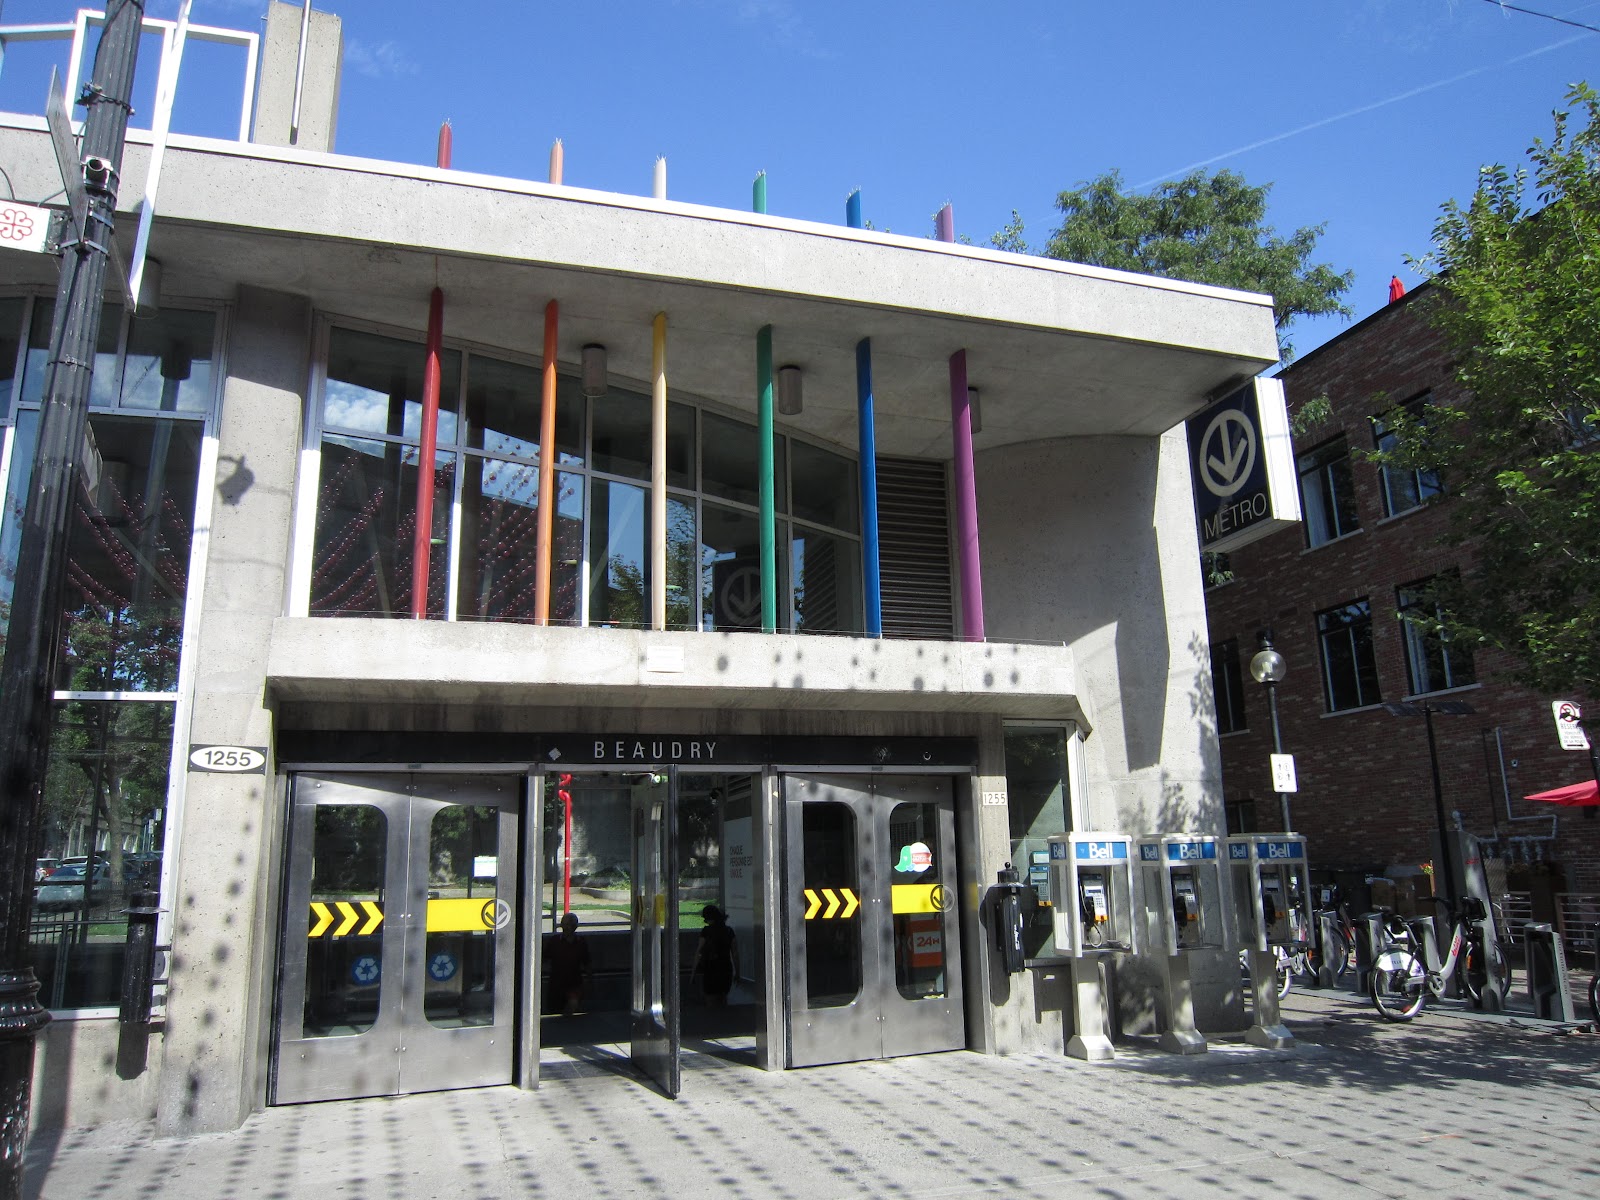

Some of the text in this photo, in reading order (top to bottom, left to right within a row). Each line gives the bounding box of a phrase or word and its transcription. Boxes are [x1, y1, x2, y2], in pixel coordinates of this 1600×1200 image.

[594, 741, 716, 759] BEAUDRY
[205, 750, 251, 767] 1255
[984, 793, 1006, 804] 1255
[1053, 843, 1065, 858] Bell
[1088, 842, 1114, 859] Bell
[1144, 846, 1158, 859] Bell
[1180, 843, 1203, 859] Bell
[1232, 845, 1247, 858] Bell
[1269, 843, 1291, 858] Bell
